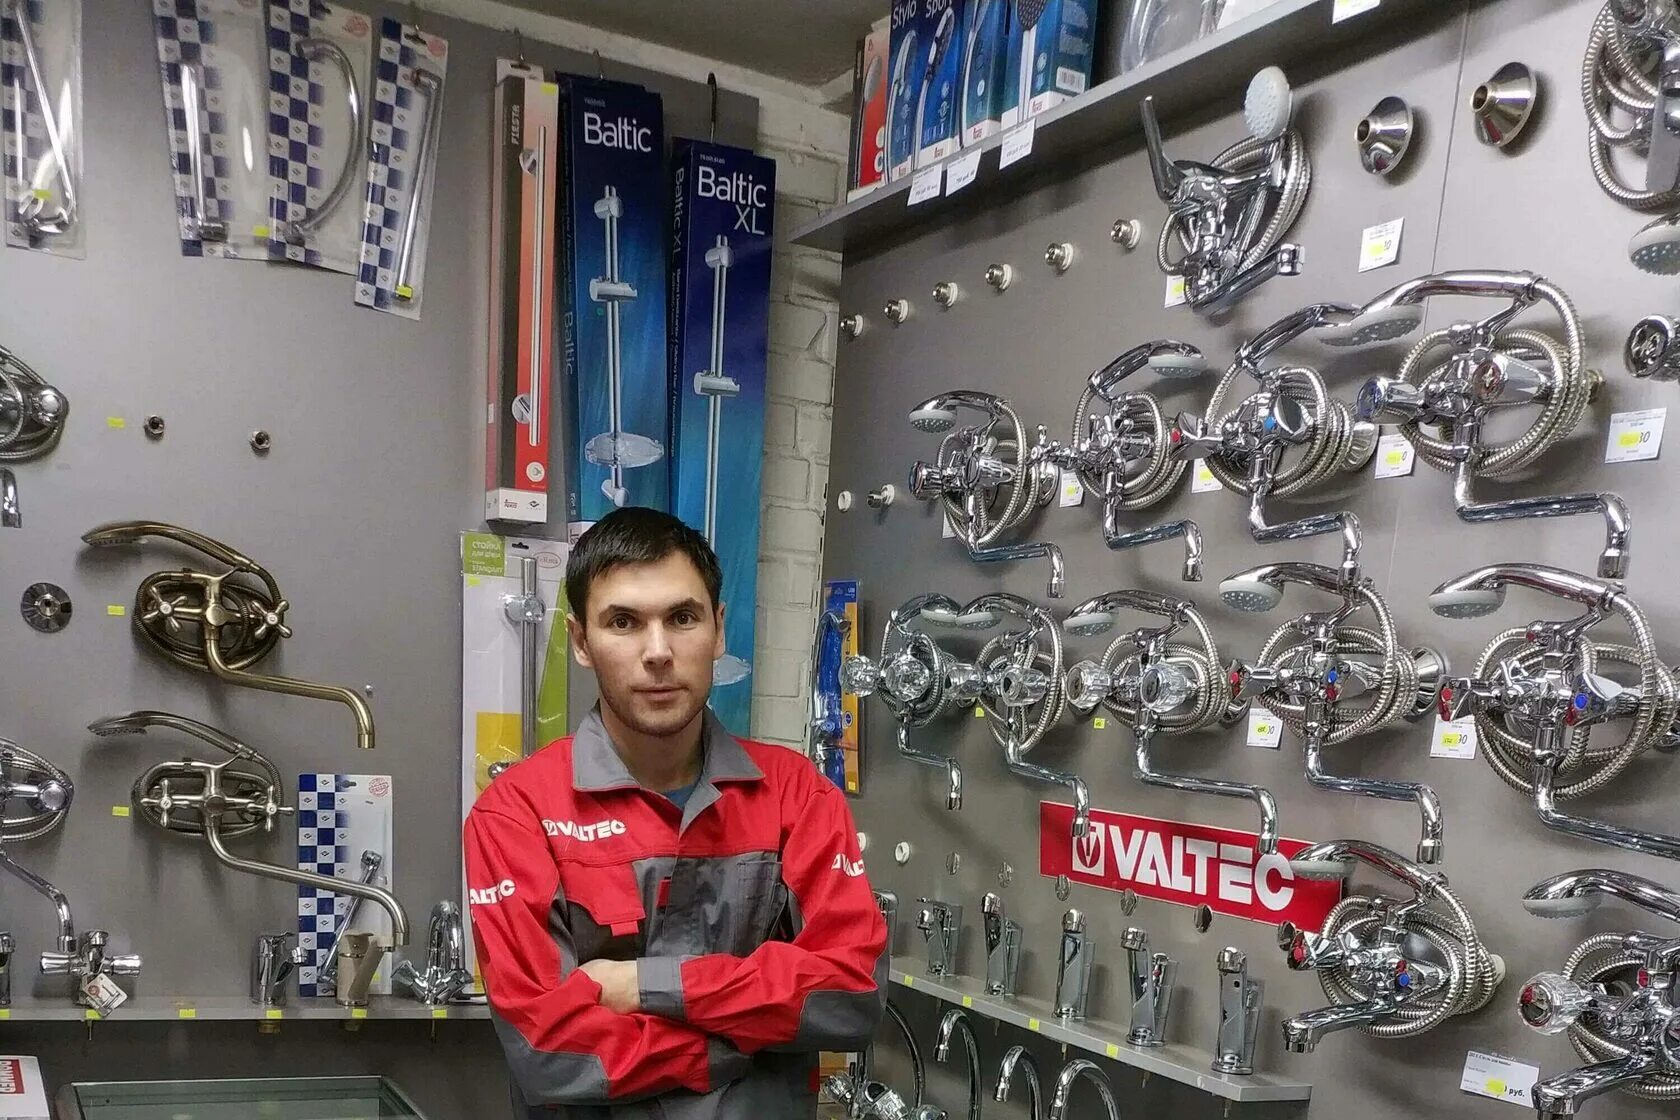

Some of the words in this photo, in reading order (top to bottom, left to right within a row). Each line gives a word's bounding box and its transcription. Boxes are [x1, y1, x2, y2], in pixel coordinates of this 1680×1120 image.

[892, 2, 917, 29] Stylo
[926, 0, 951, 18] Spor
[511, 104, 520, 145] FIESTA
[584, 112, 651, 152] Baltic
[671, 167, 685, 230] Baltic
[697, 165, 767, 208] Baltic
[733, 204, 766, 235] XL
[564, 312, 575, 375] Baltic
[556, 819, 627, 842] VALTEC
[1107, 824, 1296, 911] VALTEC
[1508, 1087, 1525, 1098] руб.
